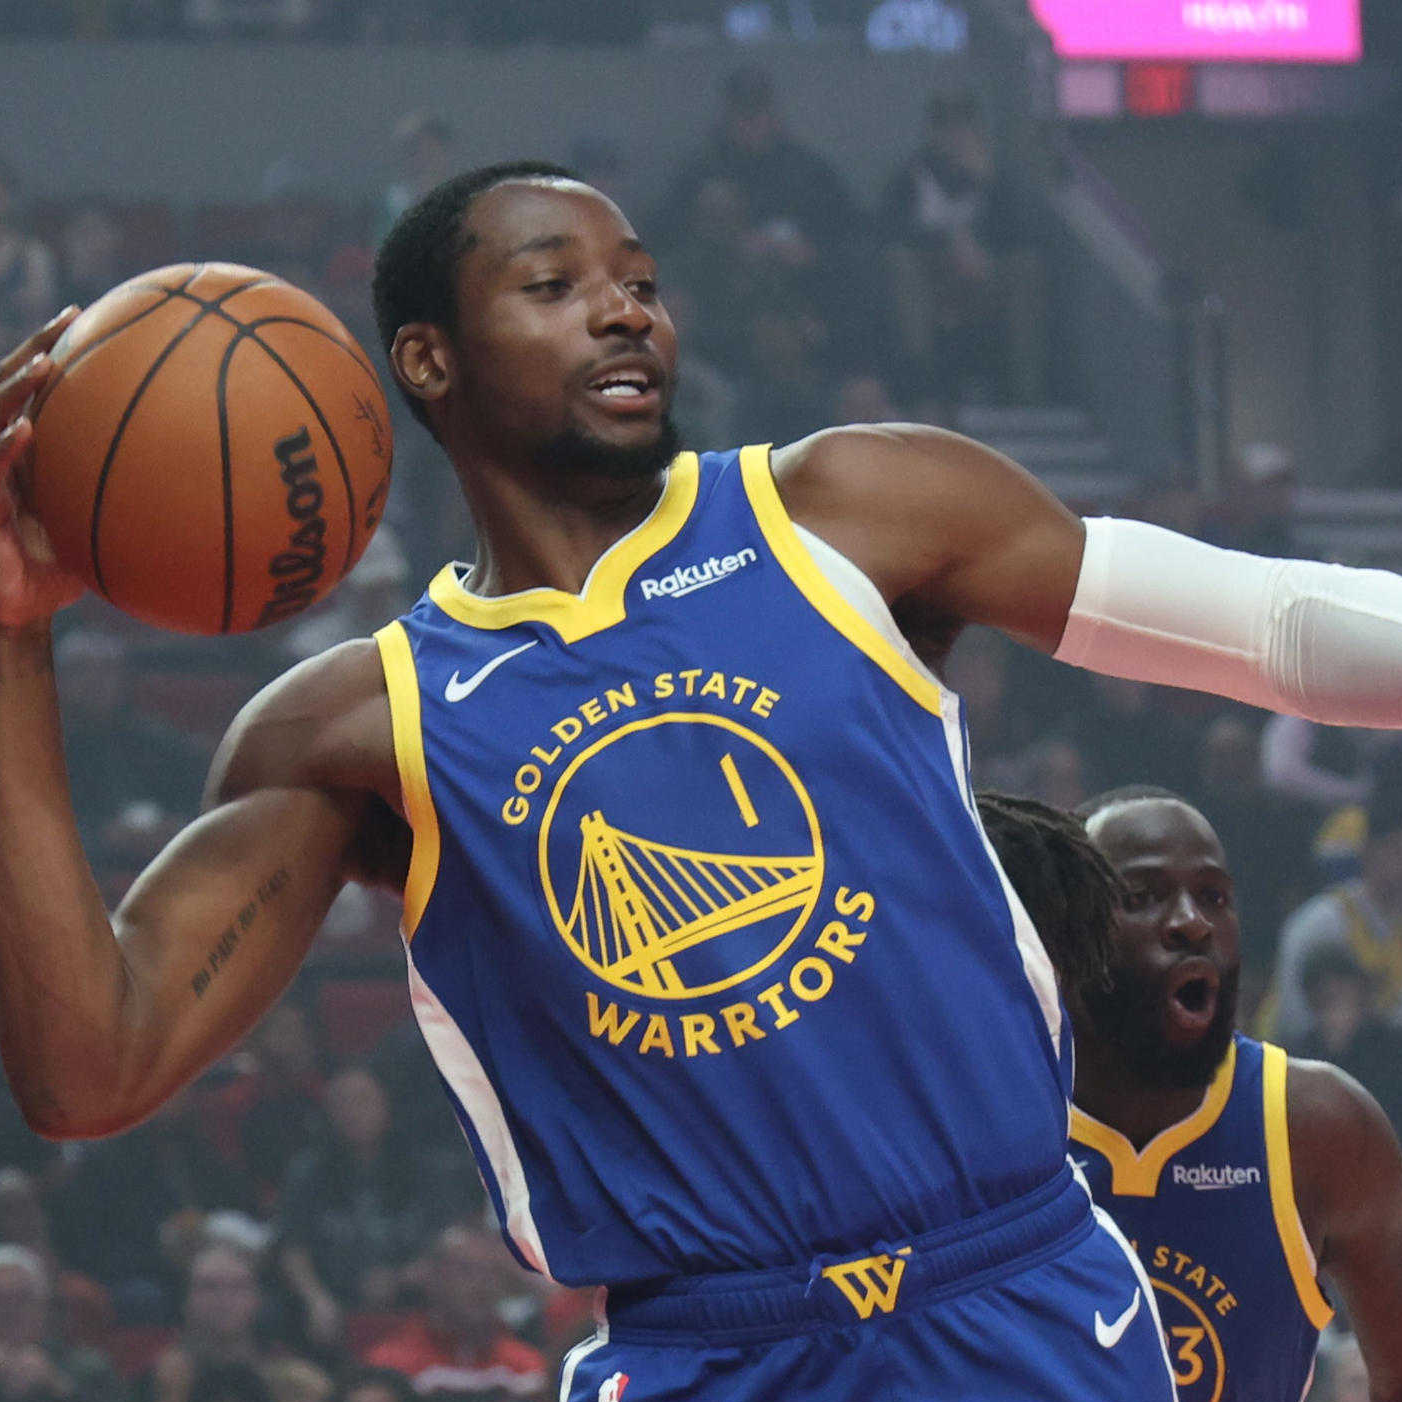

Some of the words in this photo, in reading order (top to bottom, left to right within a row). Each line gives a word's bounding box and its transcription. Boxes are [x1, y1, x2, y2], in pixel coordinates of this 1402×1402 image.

[640, 547, 757, 600] Rakuten
[502, 682, 637, 825] GOLDEN
[654, 668, 781, 719] STATE
[719, 752, 760, 829] 1
[585, 886, 876, 1059] WARRIORS
[1173, 1164, 1261, 1190] Rakuten
[1153, 1246, 1238, 1317] STATE
[1165, 1326, 1205, 1386] 3
